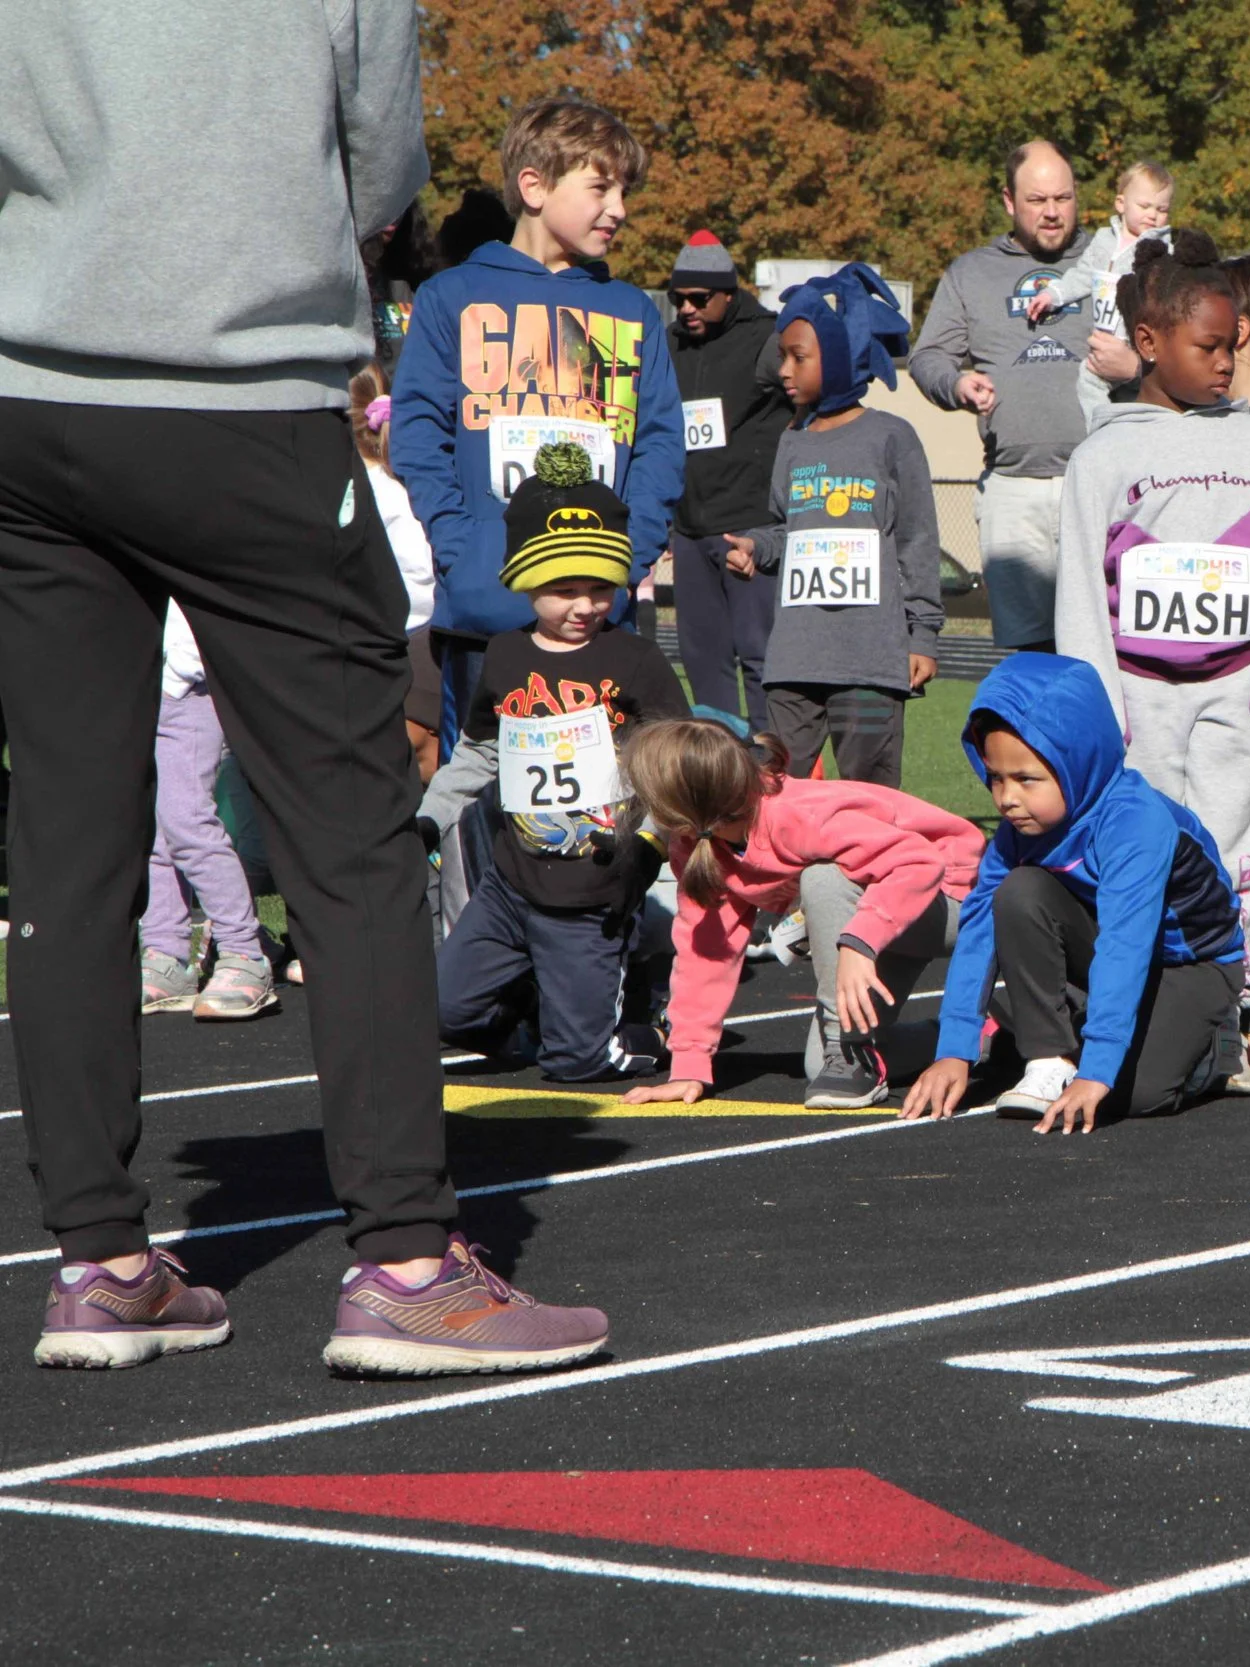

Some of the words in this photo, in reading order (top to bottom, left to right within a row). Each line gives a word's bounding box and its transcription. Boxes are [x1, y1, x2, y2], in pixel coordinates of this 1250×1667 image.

[460, 303, 643, 412] GAME
[1027, 347, 1067, 358] EDDYLINE
[851, 501, 873, 513] 2021
[795, 540, 865, 556] MEMPHIS
[790, 566, 871, 601] DASH
[1134, 589, 1250, 636] DASH
[508, 724, 594, 749] MEMPHIS
[526, 761, 581, 806] 25
